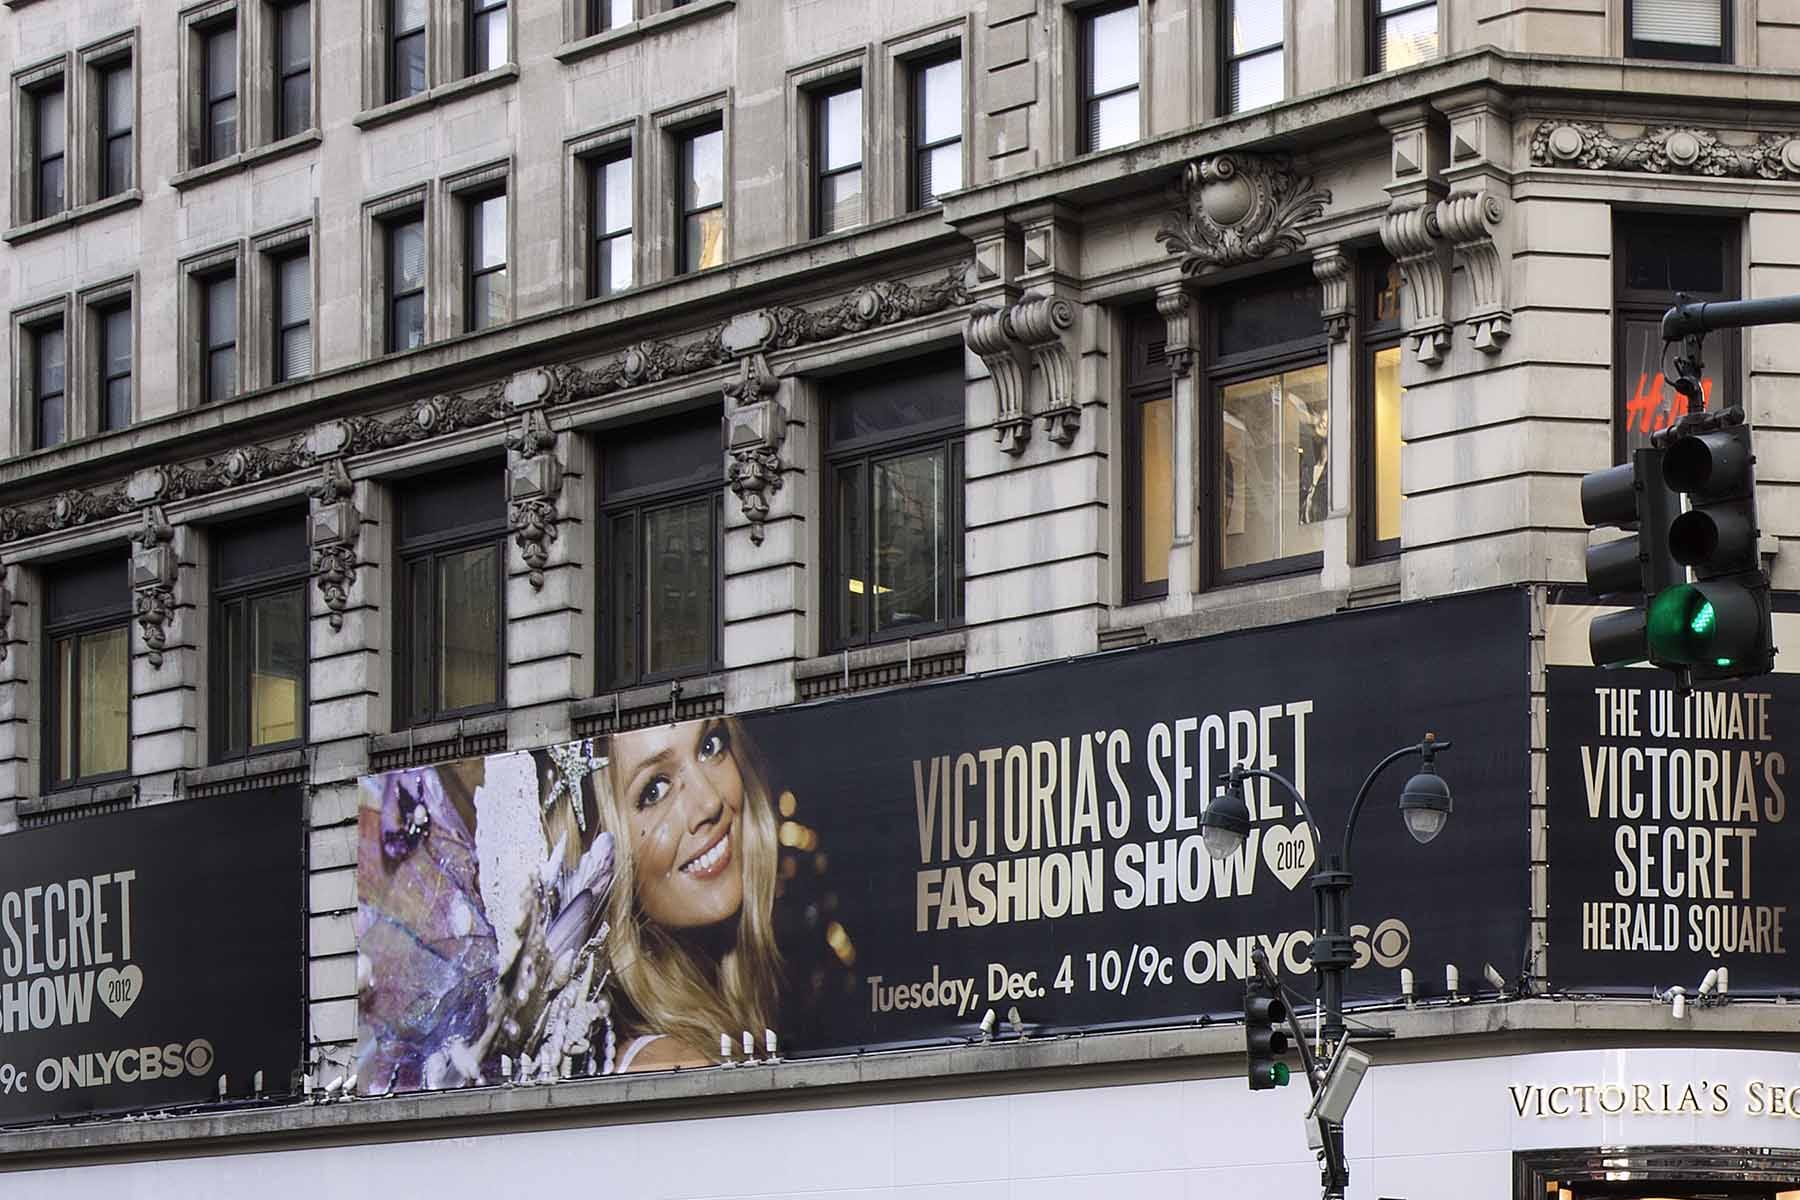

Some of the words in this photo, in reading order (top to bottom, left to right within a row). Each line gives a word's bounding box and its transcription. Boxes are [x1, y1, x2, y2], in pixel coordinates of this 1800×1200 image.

[1595, 688, 1641, 737] THE
[1650, 689, 1772, 741] ULTIMATE
[913, 728, 1131, 863] VICTORIA'S
[1148, 700, 1313, 833] SECRET
[1581, 745, 1785, 823] VICTORIA'S
[916, 848, 1104, 932] FASHION
[1114, 827, 1259, 910] SHOW
[1276, 838, 1305, 871] 2012
[1615, 825, 1757, 899] SECRET
[1, 870, 136, 977] SECRET
[1583, 902, 1680, 951] HERALD
[1688, 904, 1786, 957] SQUARE
[0, 971, 95, 1033] HOW
[109, 979, 131, 1003] 2012
[867, 967, 979, 1017] Tuesday,
[987, 964, 1045, 1001] Dec.
[1054, 955, 1074, 995] 4
[1087, 944, 1174, 996] 10/9c
[1184, 924, 1371, 985] ONLYCS
[1509, 1082, 1728, 1117] VICTORIA'S
